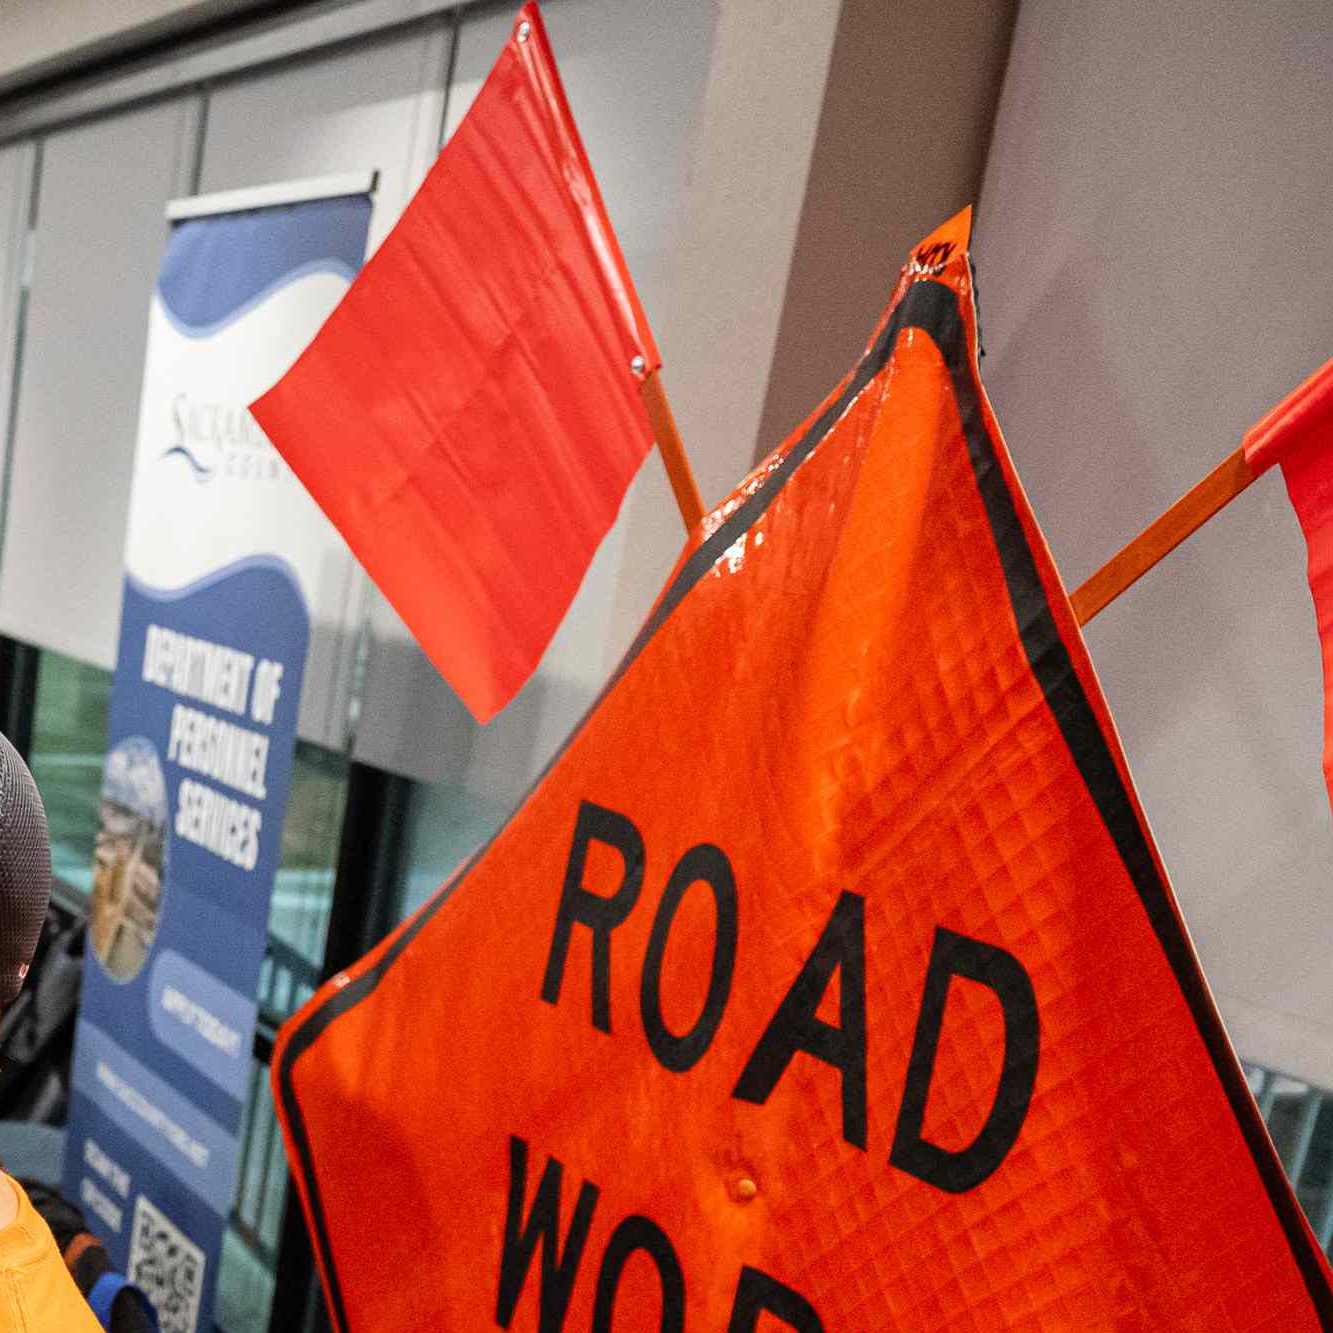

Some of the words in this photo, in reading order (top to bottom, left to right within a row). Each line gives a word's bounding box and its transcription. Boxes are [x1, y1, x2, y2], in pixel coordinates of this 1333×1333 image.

[251, 659, 283, 725] OF
[175, 777, 262, 870] SERVICES
[542, 800, 1041, 1194] ROAD
